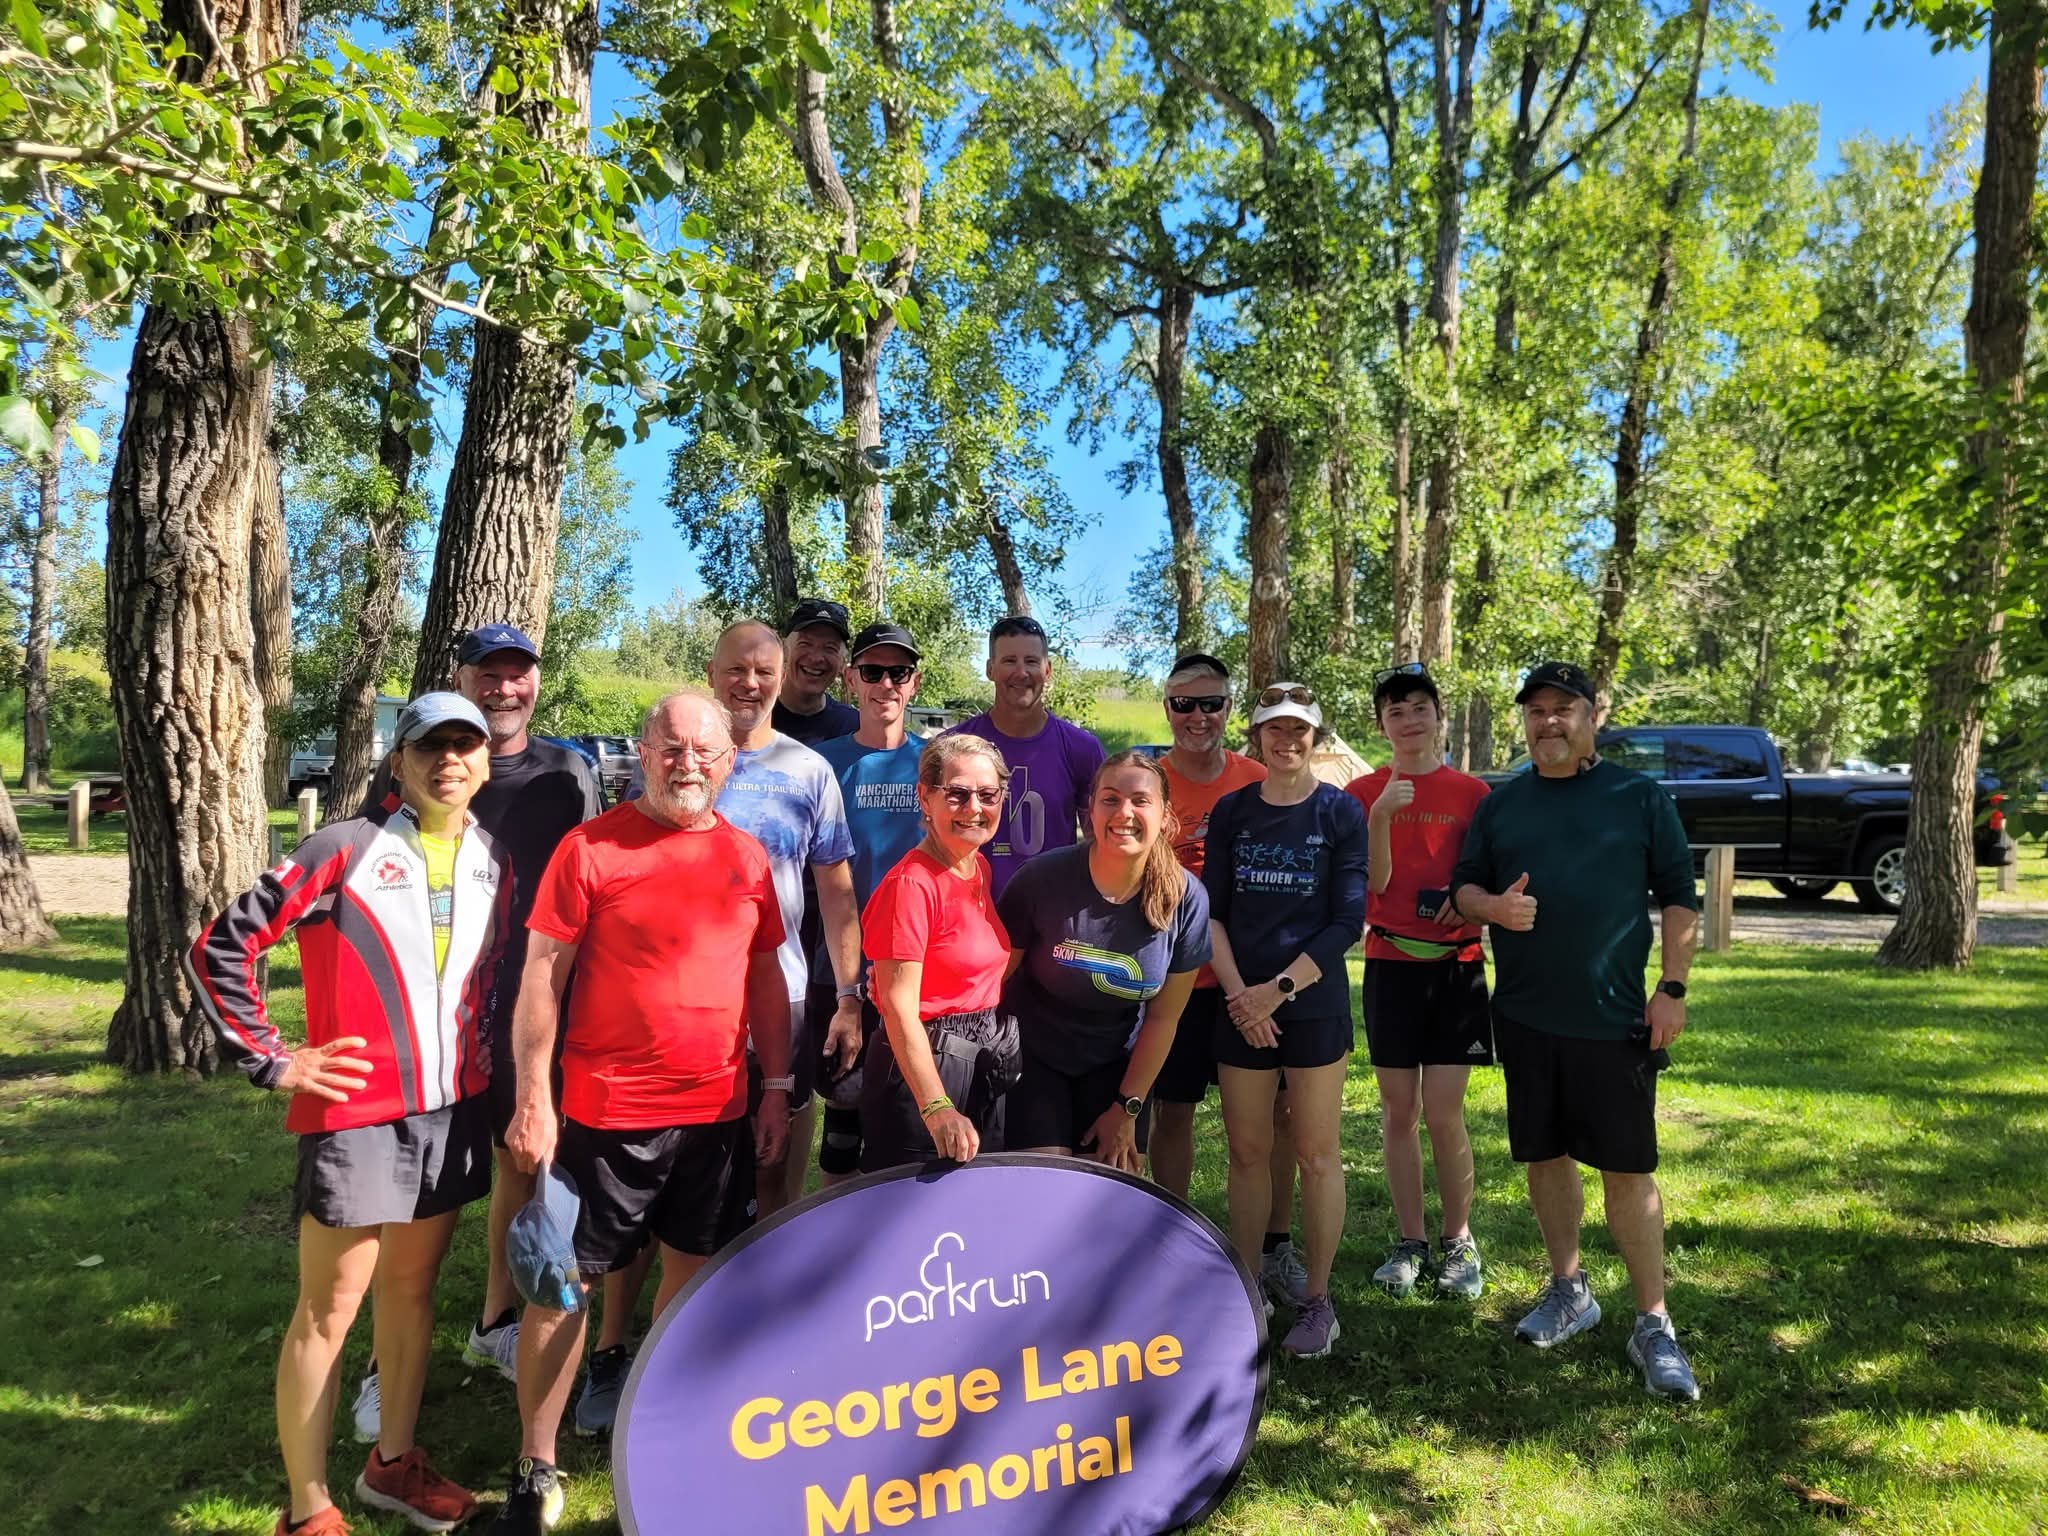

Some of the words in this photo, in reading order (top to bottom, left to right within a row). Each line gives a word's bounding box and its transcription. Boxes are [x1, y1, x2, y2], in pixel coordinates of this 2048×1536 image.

[732, 782, 760, 792] ULTRA
[762, 784, 787, 793] TRAIL
[855, 783, 913, 797] VANCOUVER
[857, 795, 912, 809] MARATHON
[1250, 871, 1293, 885] EKIDEN
[1052, 946, 1075, 961] 5KM
[864, 1252, 1050, 1342] parkrun
[731, 1367, 1000, 1460] George
[1022, 1333, 1184, 1404] Lane
[805, 1415, 1133, 1536] Memorial
